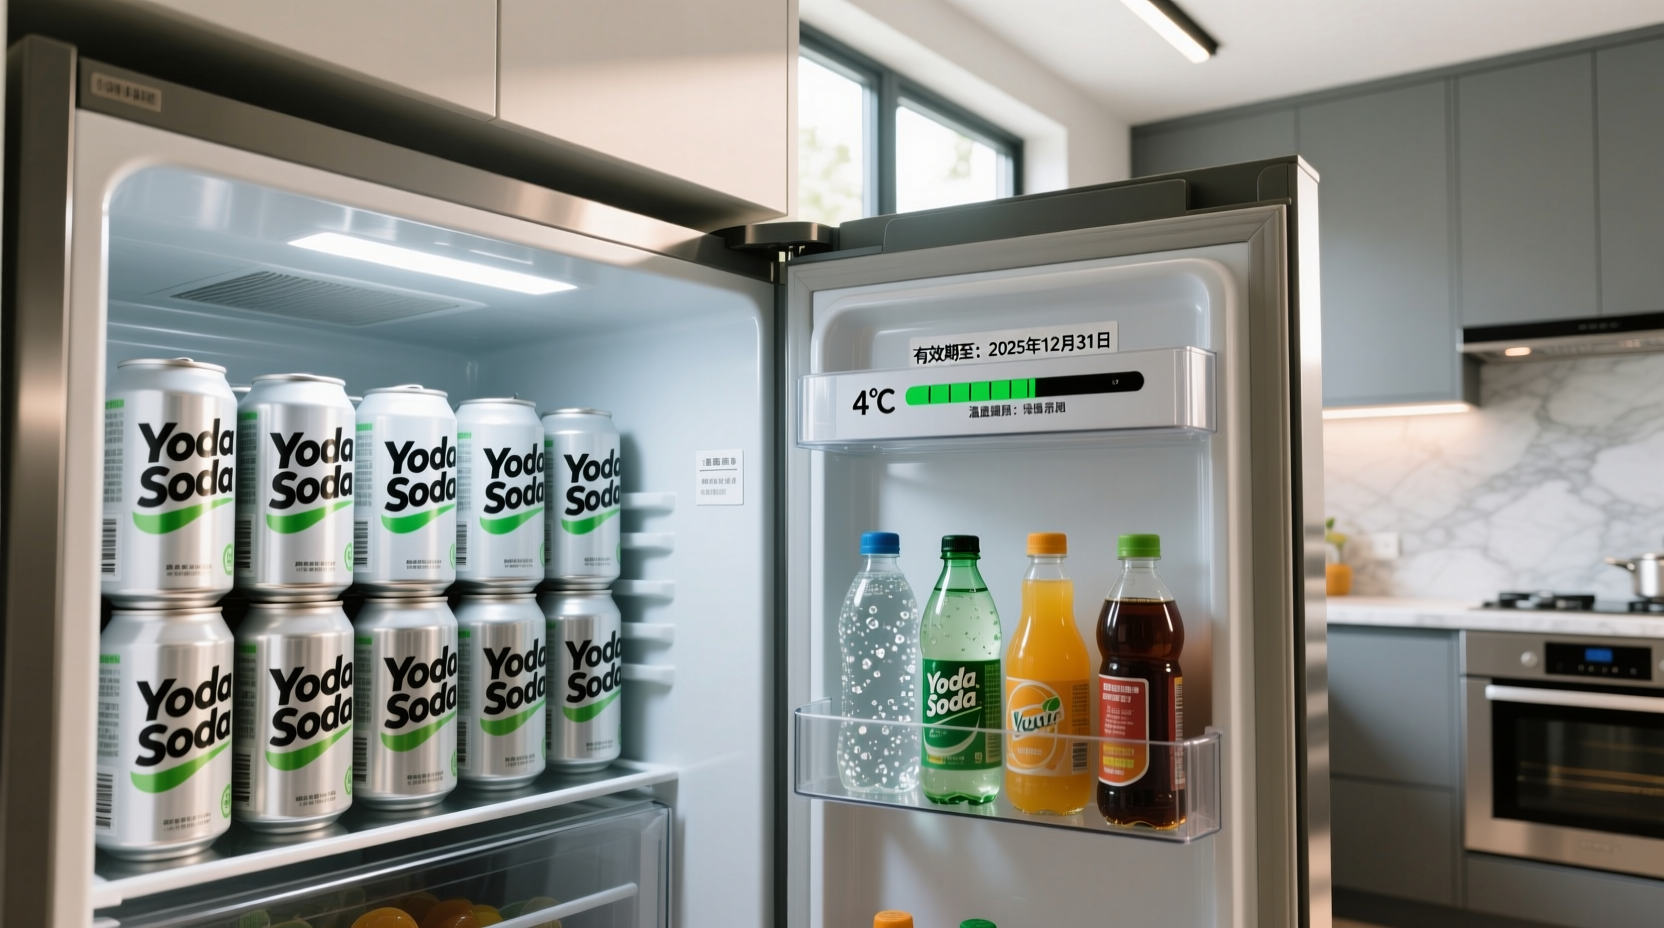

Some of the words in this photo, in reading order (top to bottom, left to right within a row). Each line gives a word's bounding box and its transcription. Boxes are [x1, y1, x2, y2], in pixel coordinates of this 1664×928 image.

[852, 387, 896, 416] 4°C
[137, 418, 234, 463] Yoda
[269, 427, 354, 469] Yoda
[384, 436, 457, 475] Yoda
[483, 443, 544, 479] Yoda
[137, 459, 233, 508] Soda
[563, 448, 620, 483] Yoda
[268, 465, 353, 510] Soda
[384, 471, 456, 512] Soda
[483, 476, 544, 514] Soda
[564, 479, 620, 515] Soda
[383, 645, 457, 692] Yoda
[482, 638, 546, 680] Yoda
[565, 630, 621, 671] Yoda
[136, 665, 232, 722] Yoda
[269, 654, 353, 706] Yoda
[483, 671, 546, 715] Soda
[565, 662, 621, 703] Soda
[926, 666, 977, 694] Yoda
[269, 693, 353, 747] Soda
[384, 681, 457, 729] Soda
[926, 688, 977, 718] Soda
[135, 706, 231, 767] Soda
